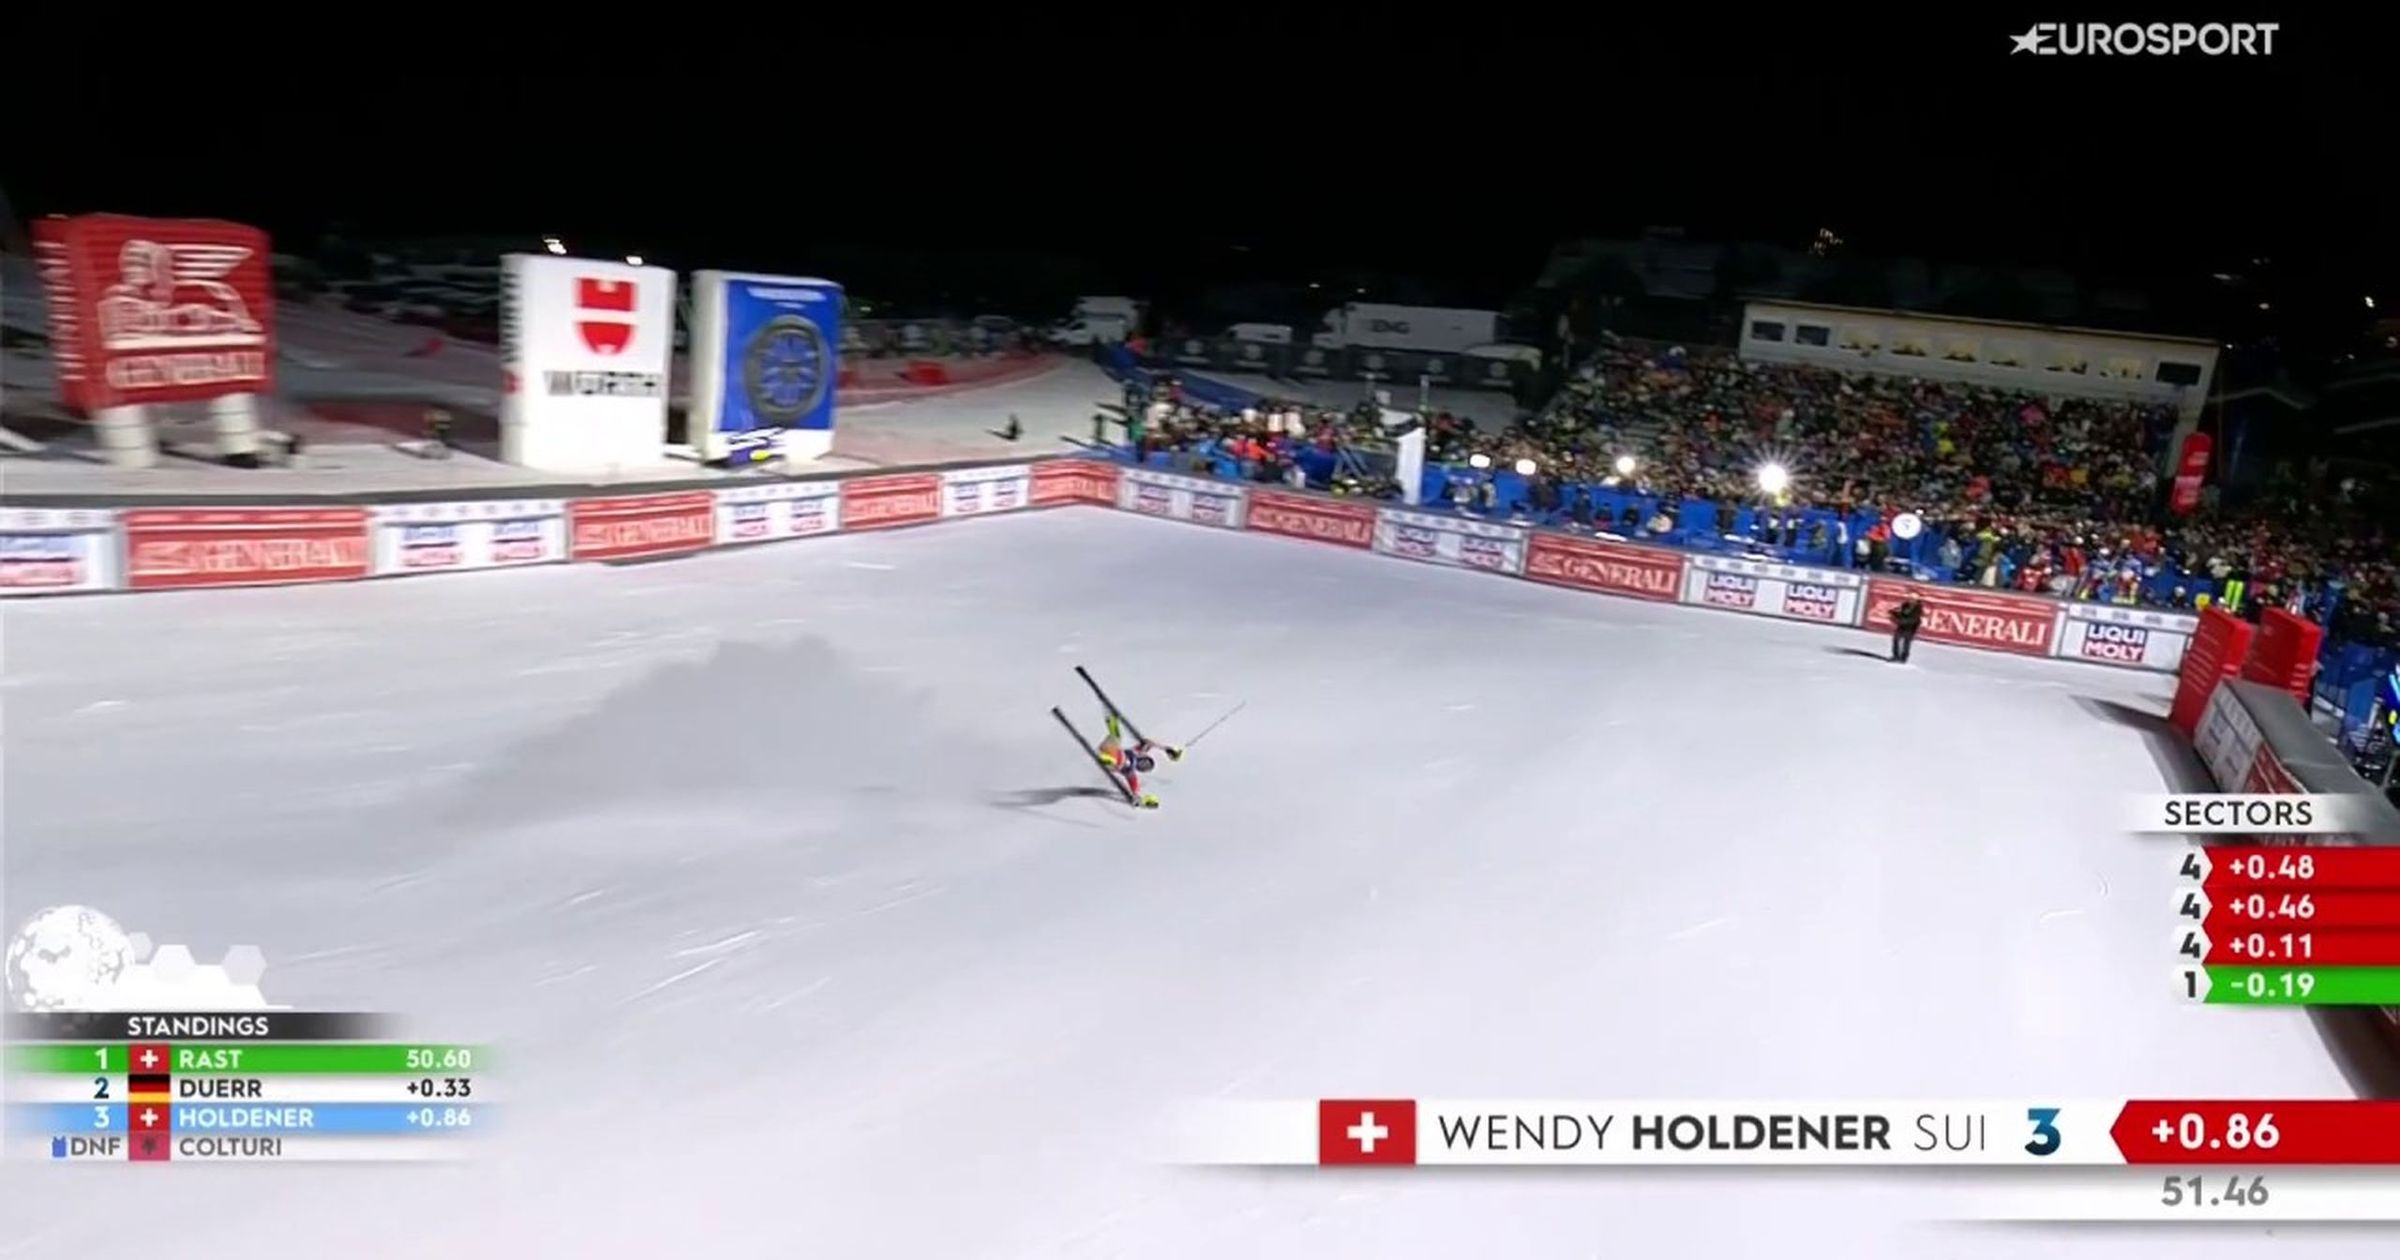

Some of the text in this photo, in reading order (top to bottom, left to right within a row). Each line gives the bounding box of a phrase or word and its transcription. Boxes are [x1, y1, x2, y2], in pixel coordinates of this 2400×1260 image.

[1564, 556, 1678, 594] GENERALI
[1919, 607, 2046, 646] GENERALI
[2087, 622, 2147, 645] LIQUI
[2084, 641, 2145, 662] MOLY
